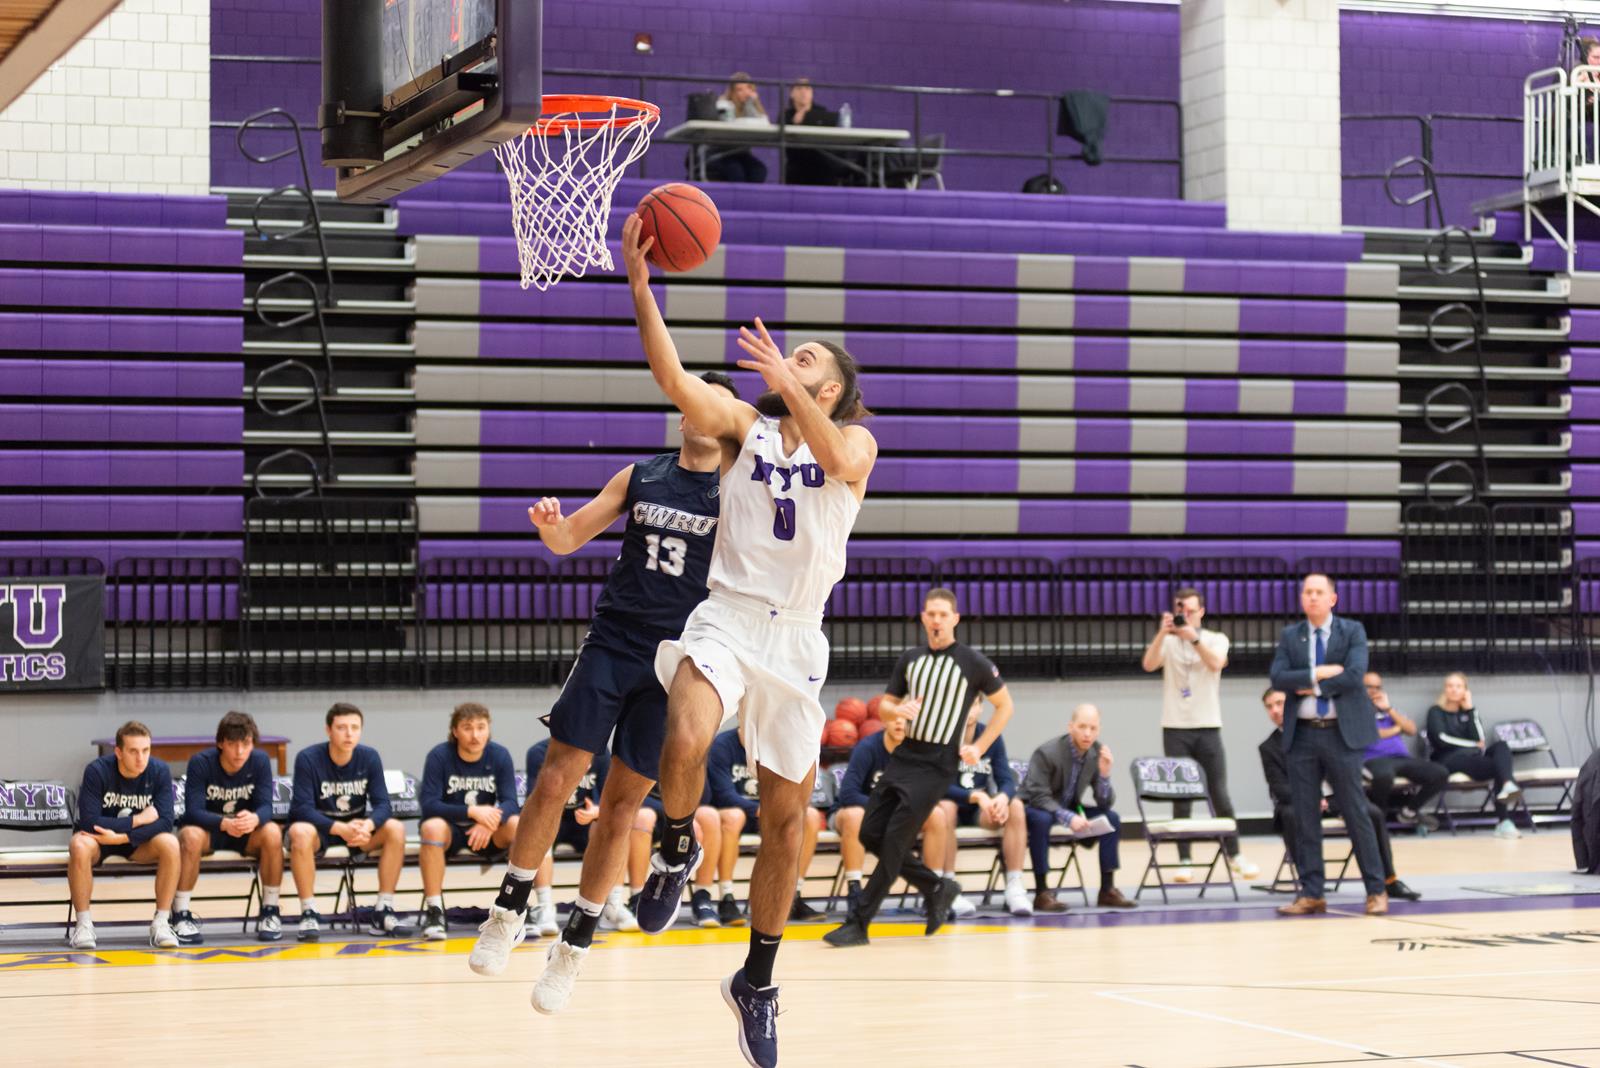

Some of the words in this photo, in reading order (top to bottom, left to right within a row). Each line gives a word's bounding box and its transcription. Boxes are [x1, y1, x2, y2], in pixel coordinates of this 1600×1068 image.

[751, 454, 825, 492] NYU
[632, 500, 720, 537] CWRU
[773, 497, 796, 541] 0
[644, 533, 688, 578] 13
[0, 782, 65, 807] NYU
[319, 778, 368, 800] SPARTANS
[447, 774, 496, 795] SPARTANS
[102, 791, 154, 810] SPARTANS
